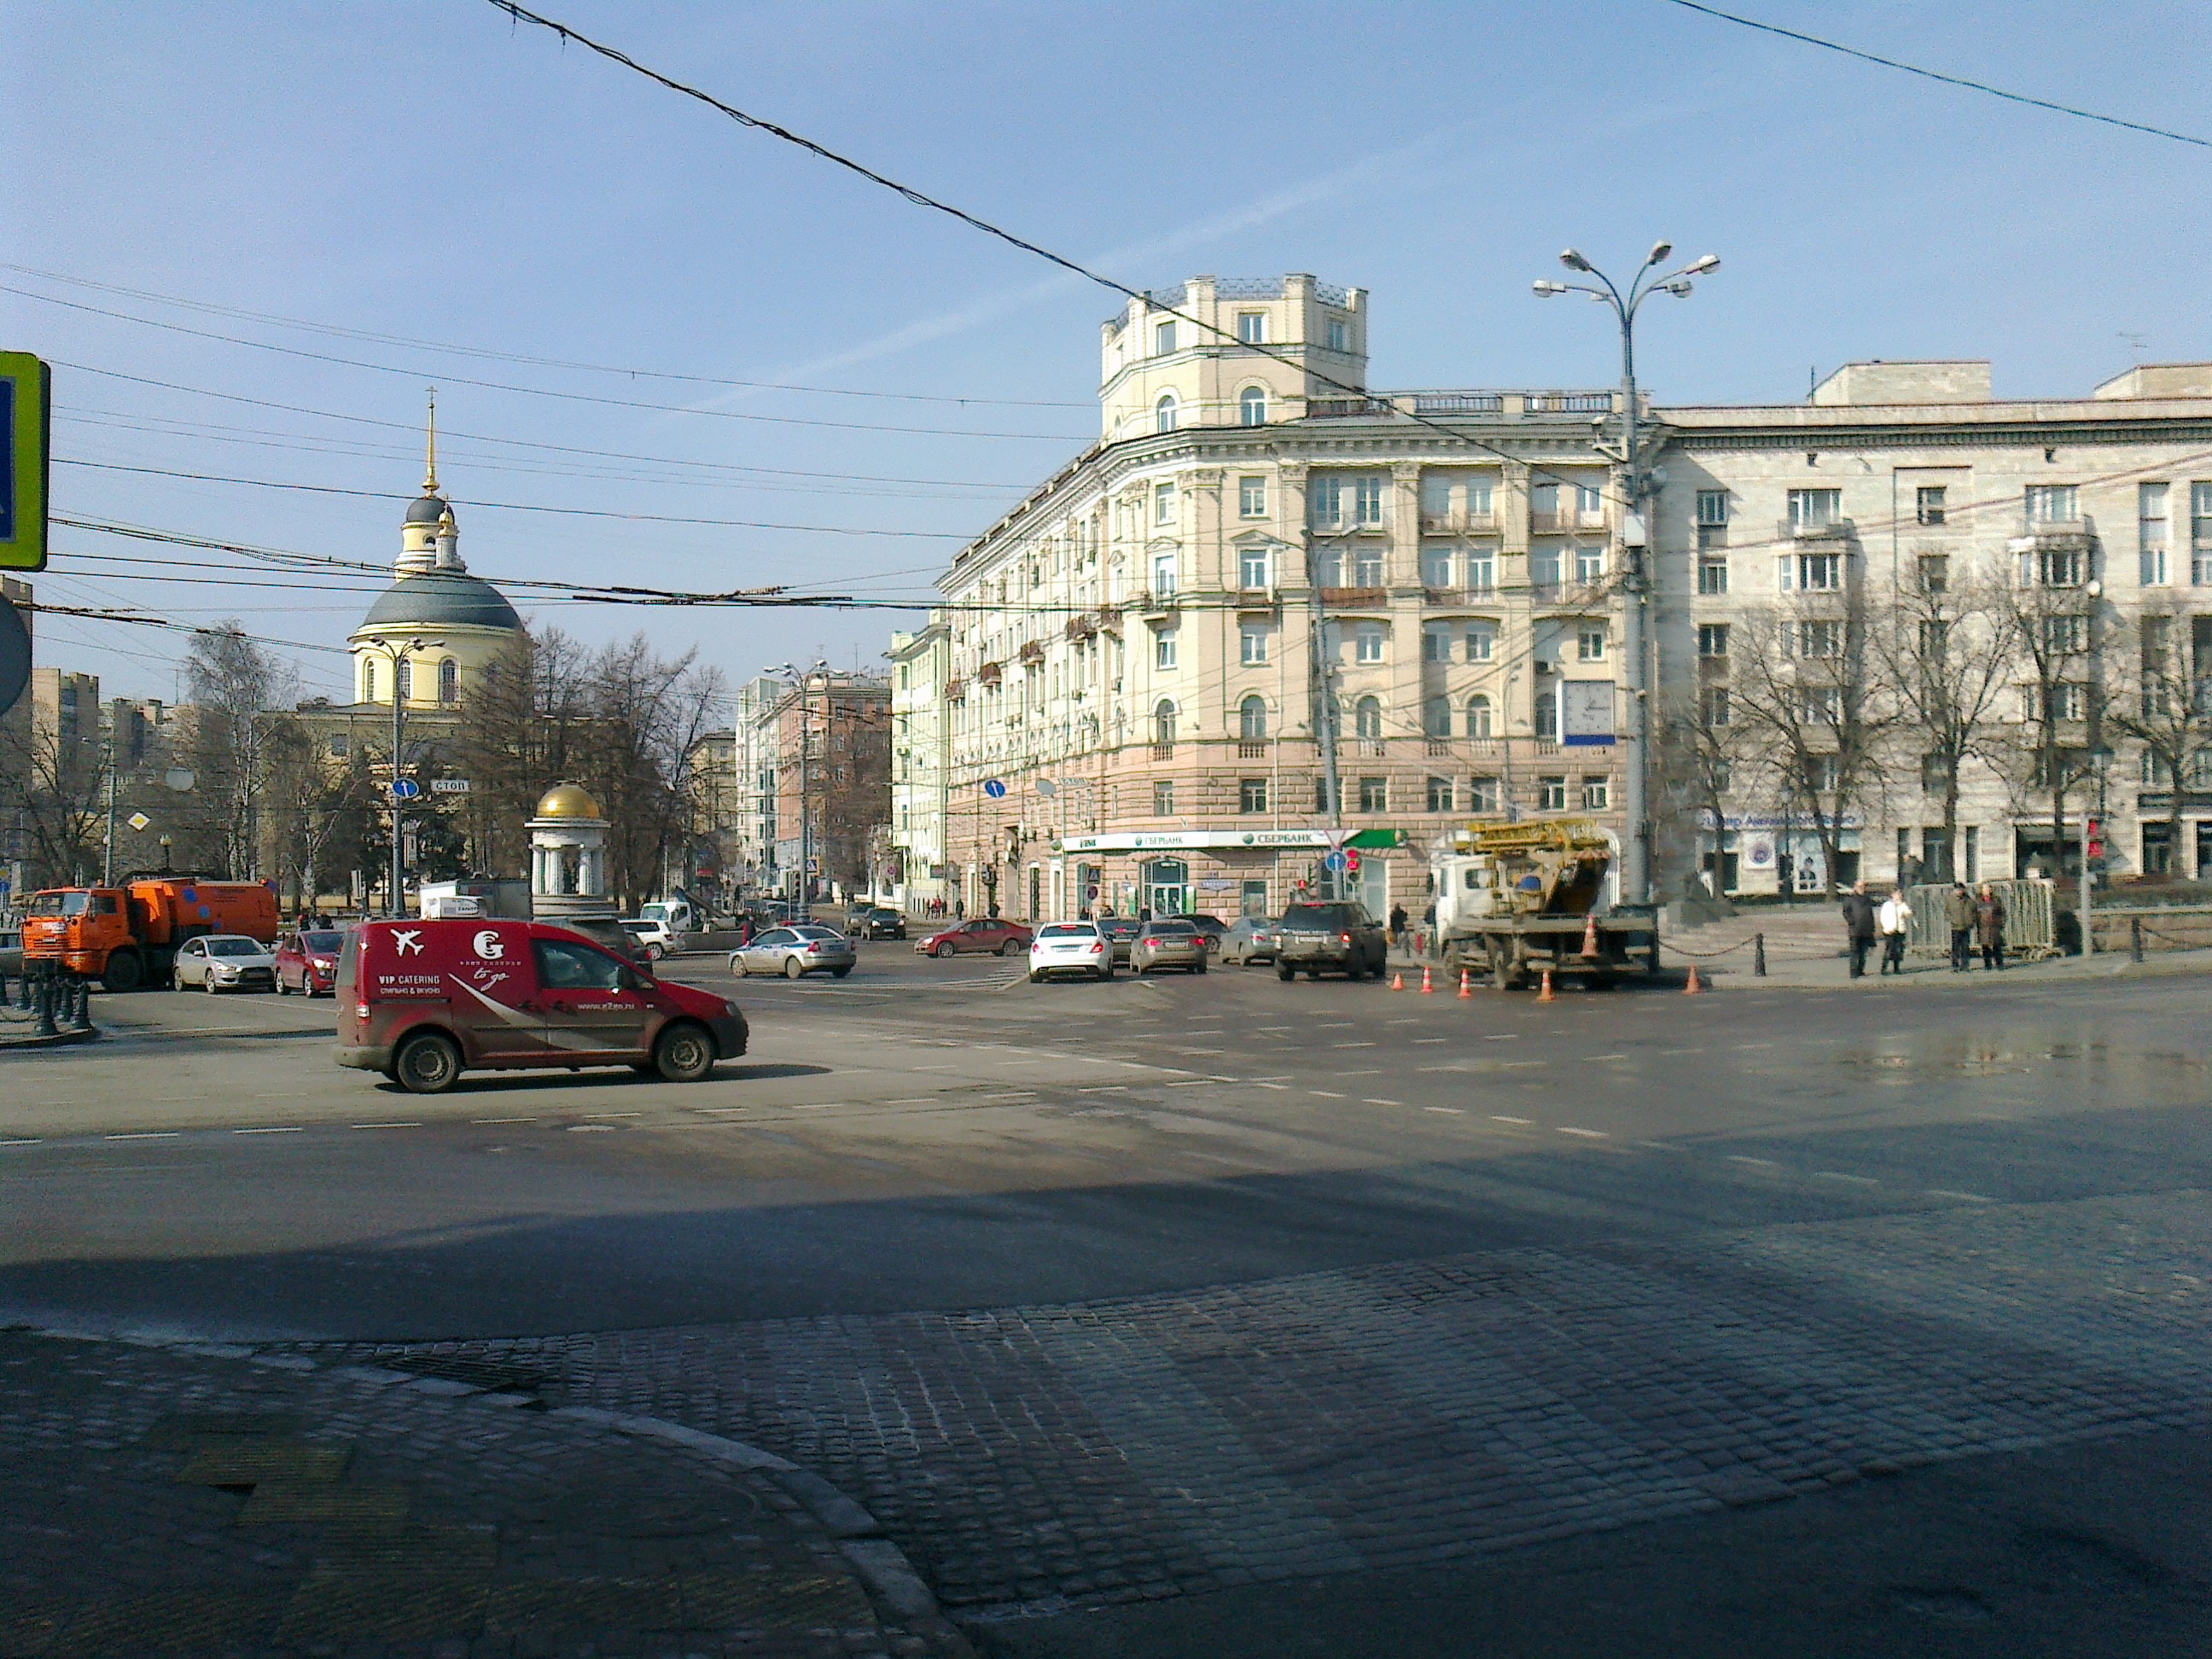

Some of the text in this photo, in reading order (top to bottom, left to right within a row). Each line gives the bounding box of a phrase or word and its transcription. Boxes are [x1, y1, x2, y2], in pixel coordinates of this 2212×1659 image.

[436, 782, 465, 790] СТОП
[1144, 836, 1184, 845] СБЕРБАНК
[1258, 833, 1313, 843] СБЕРБАНК
[379, 975, 440, 985] VIP CATERING
[474, 967, 510, 992] to go
[410, 987, 416, 995] &
